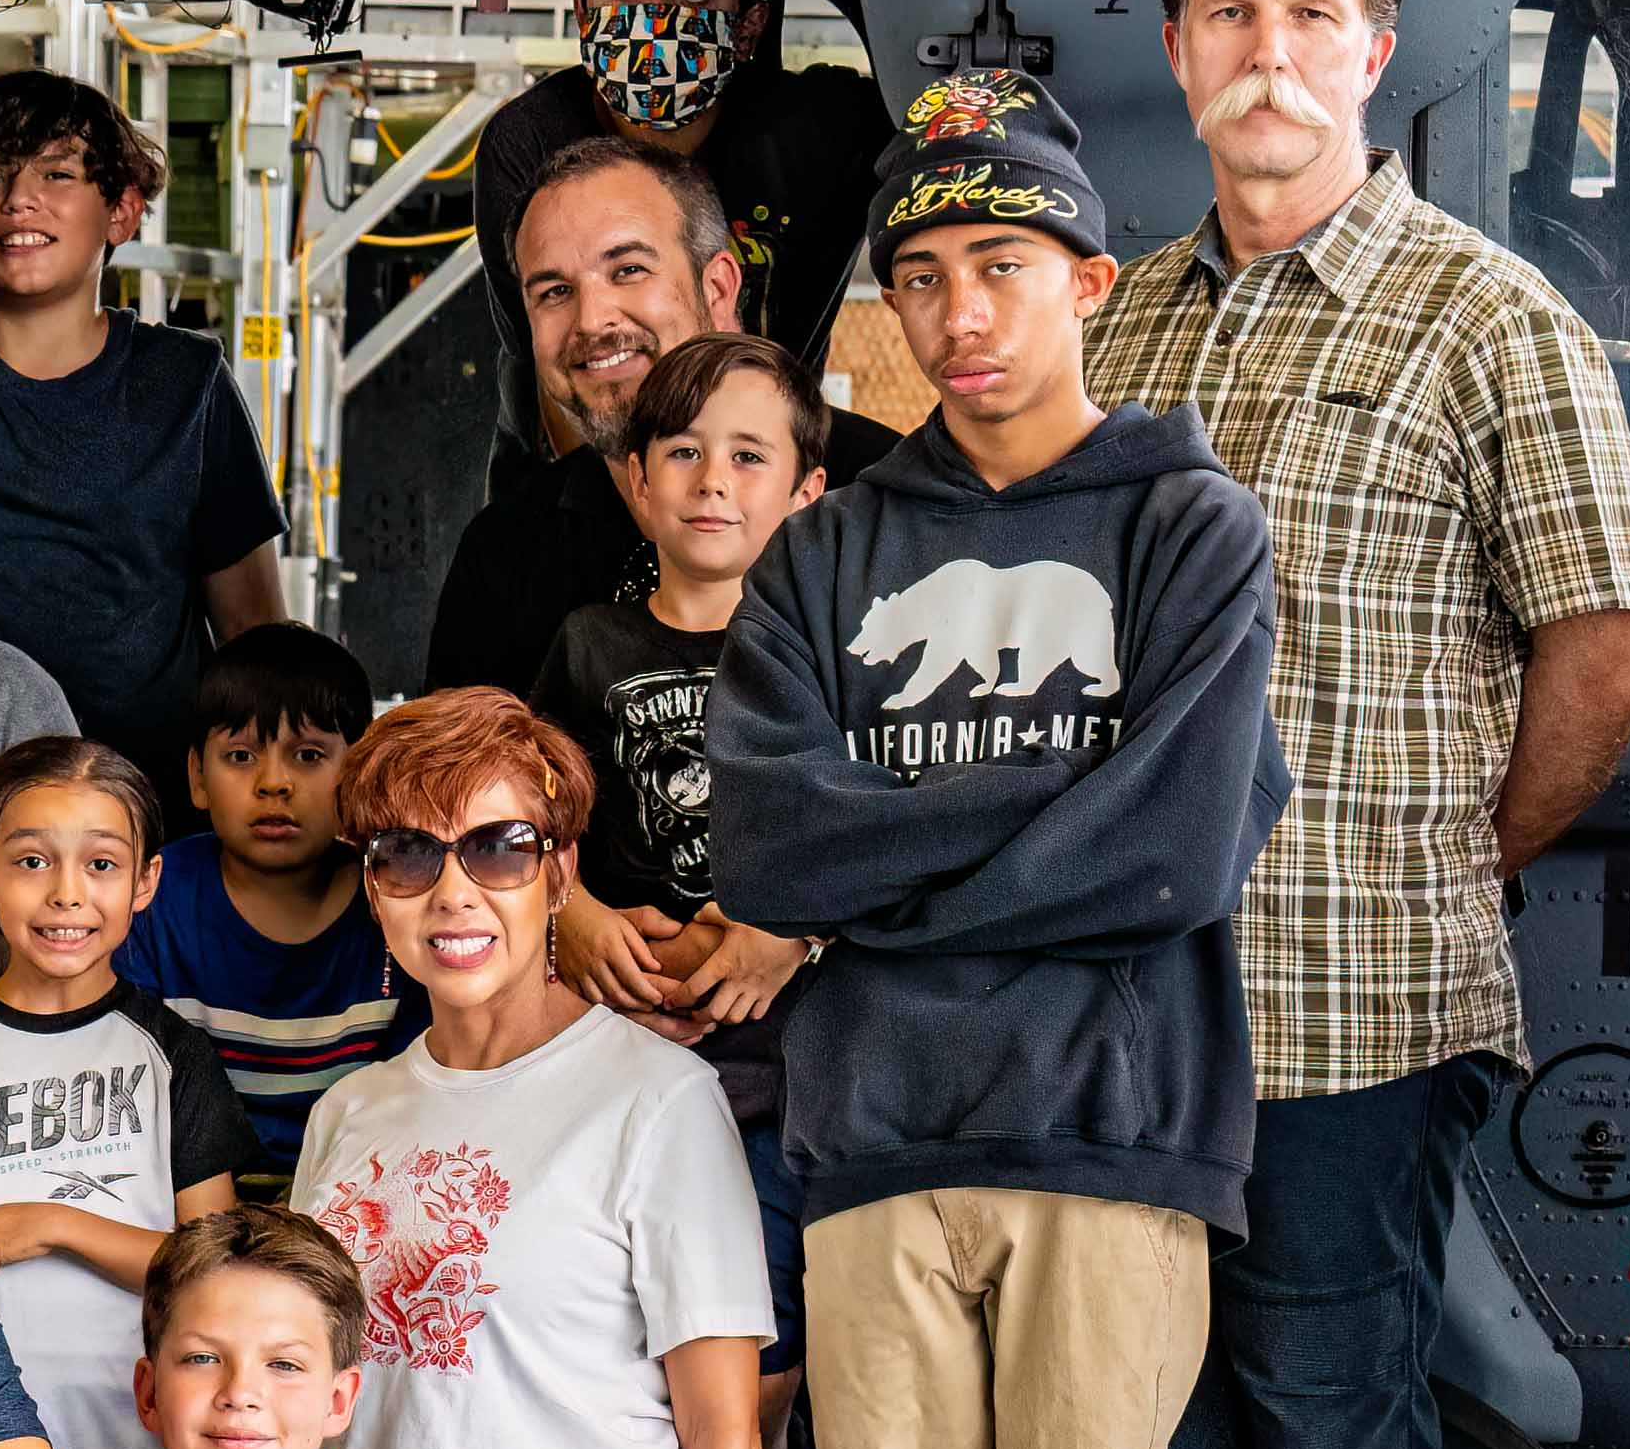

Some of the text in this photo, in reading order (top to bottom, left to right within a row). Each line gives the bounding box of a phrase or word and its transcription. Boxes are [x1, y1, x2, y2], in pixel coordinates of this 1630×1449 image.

[932, 178, 1079, 220] Hardy
[0, 1157, 43, 1175] SPEED
[59, 1141, 133, 1162] STRENGTH
